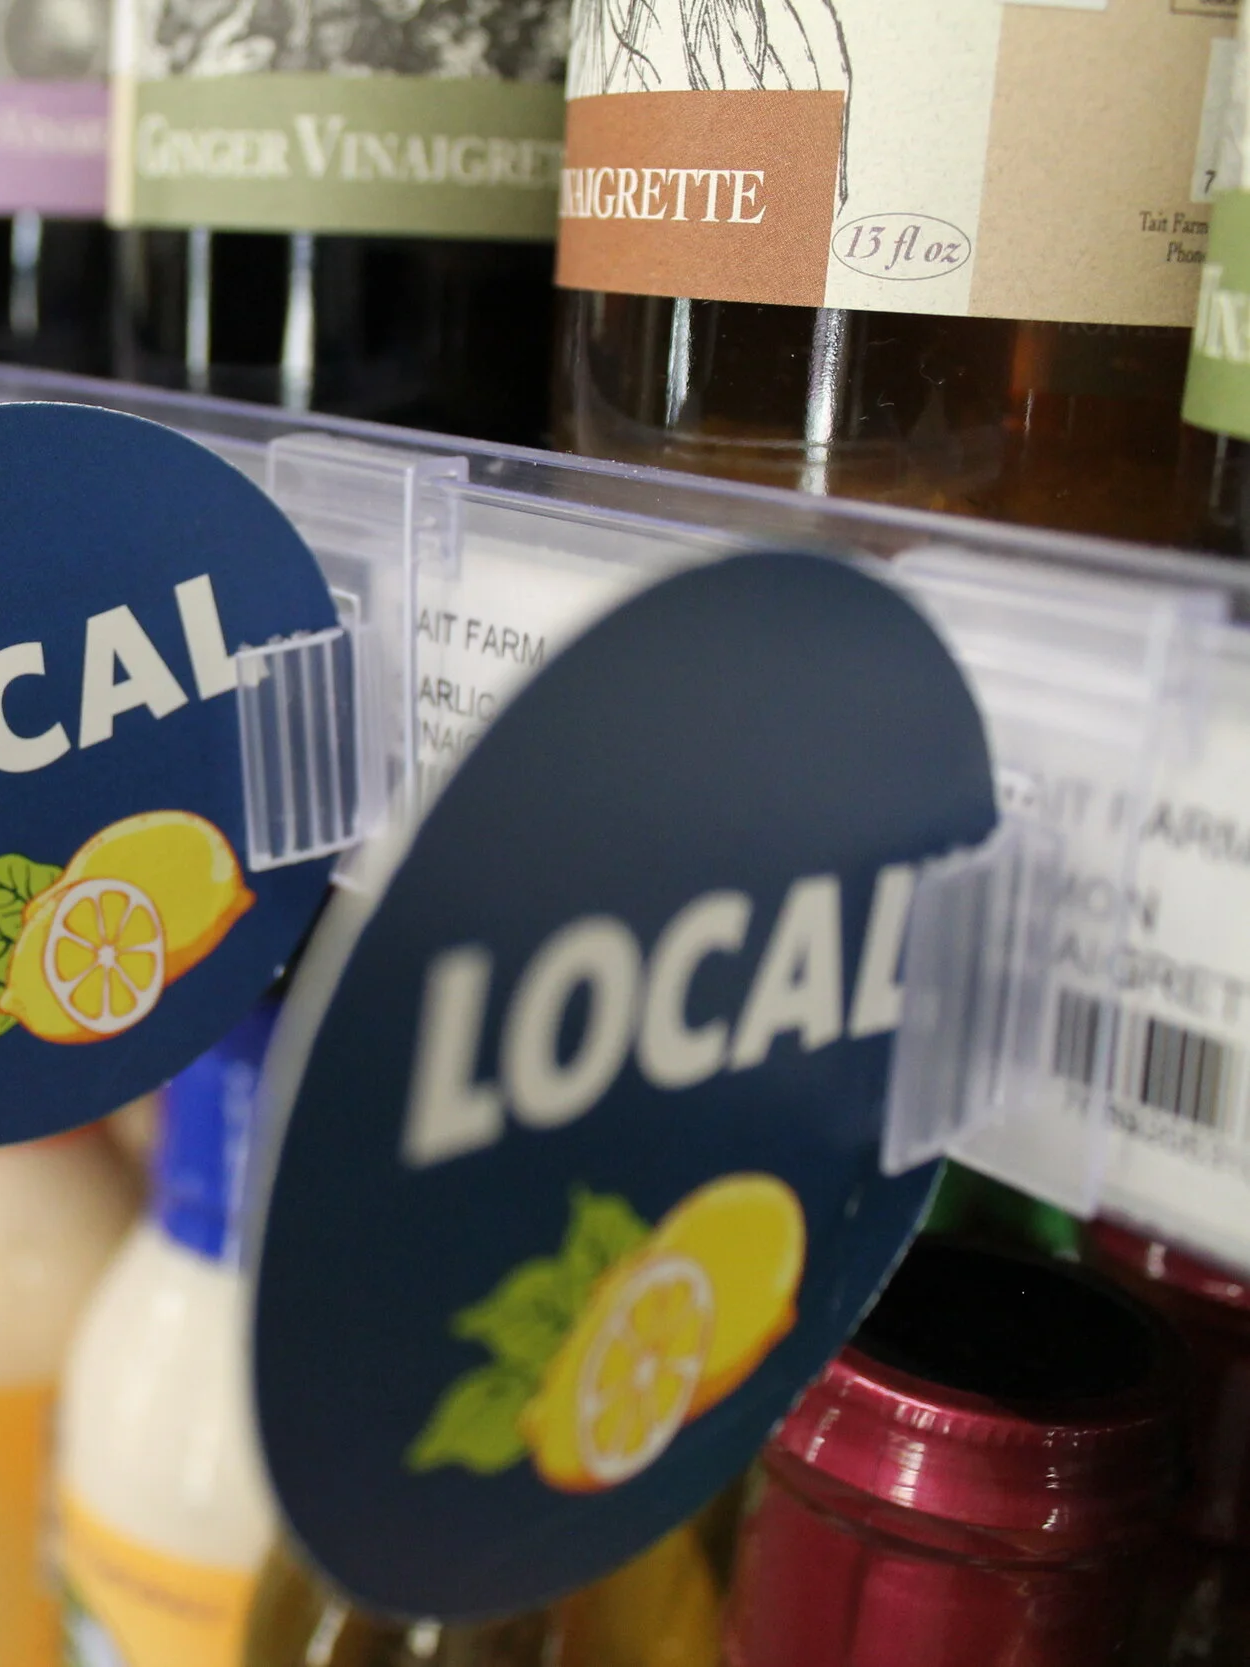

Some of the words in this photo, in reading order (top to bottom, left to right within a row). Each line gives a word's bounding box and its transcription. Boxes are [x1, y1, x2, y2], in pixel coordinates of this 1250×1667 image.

[136, 112, 290, 179] GINGER
[1139, 210, 1168, 232] Tait
[844, 225, 886, 259] 13
[884, 224, 922, 271] fl
[923, 241, 962, 264] oz
[418, 608, 458, 646] AIT
[400, 862, 922, 1168] LOCAL
